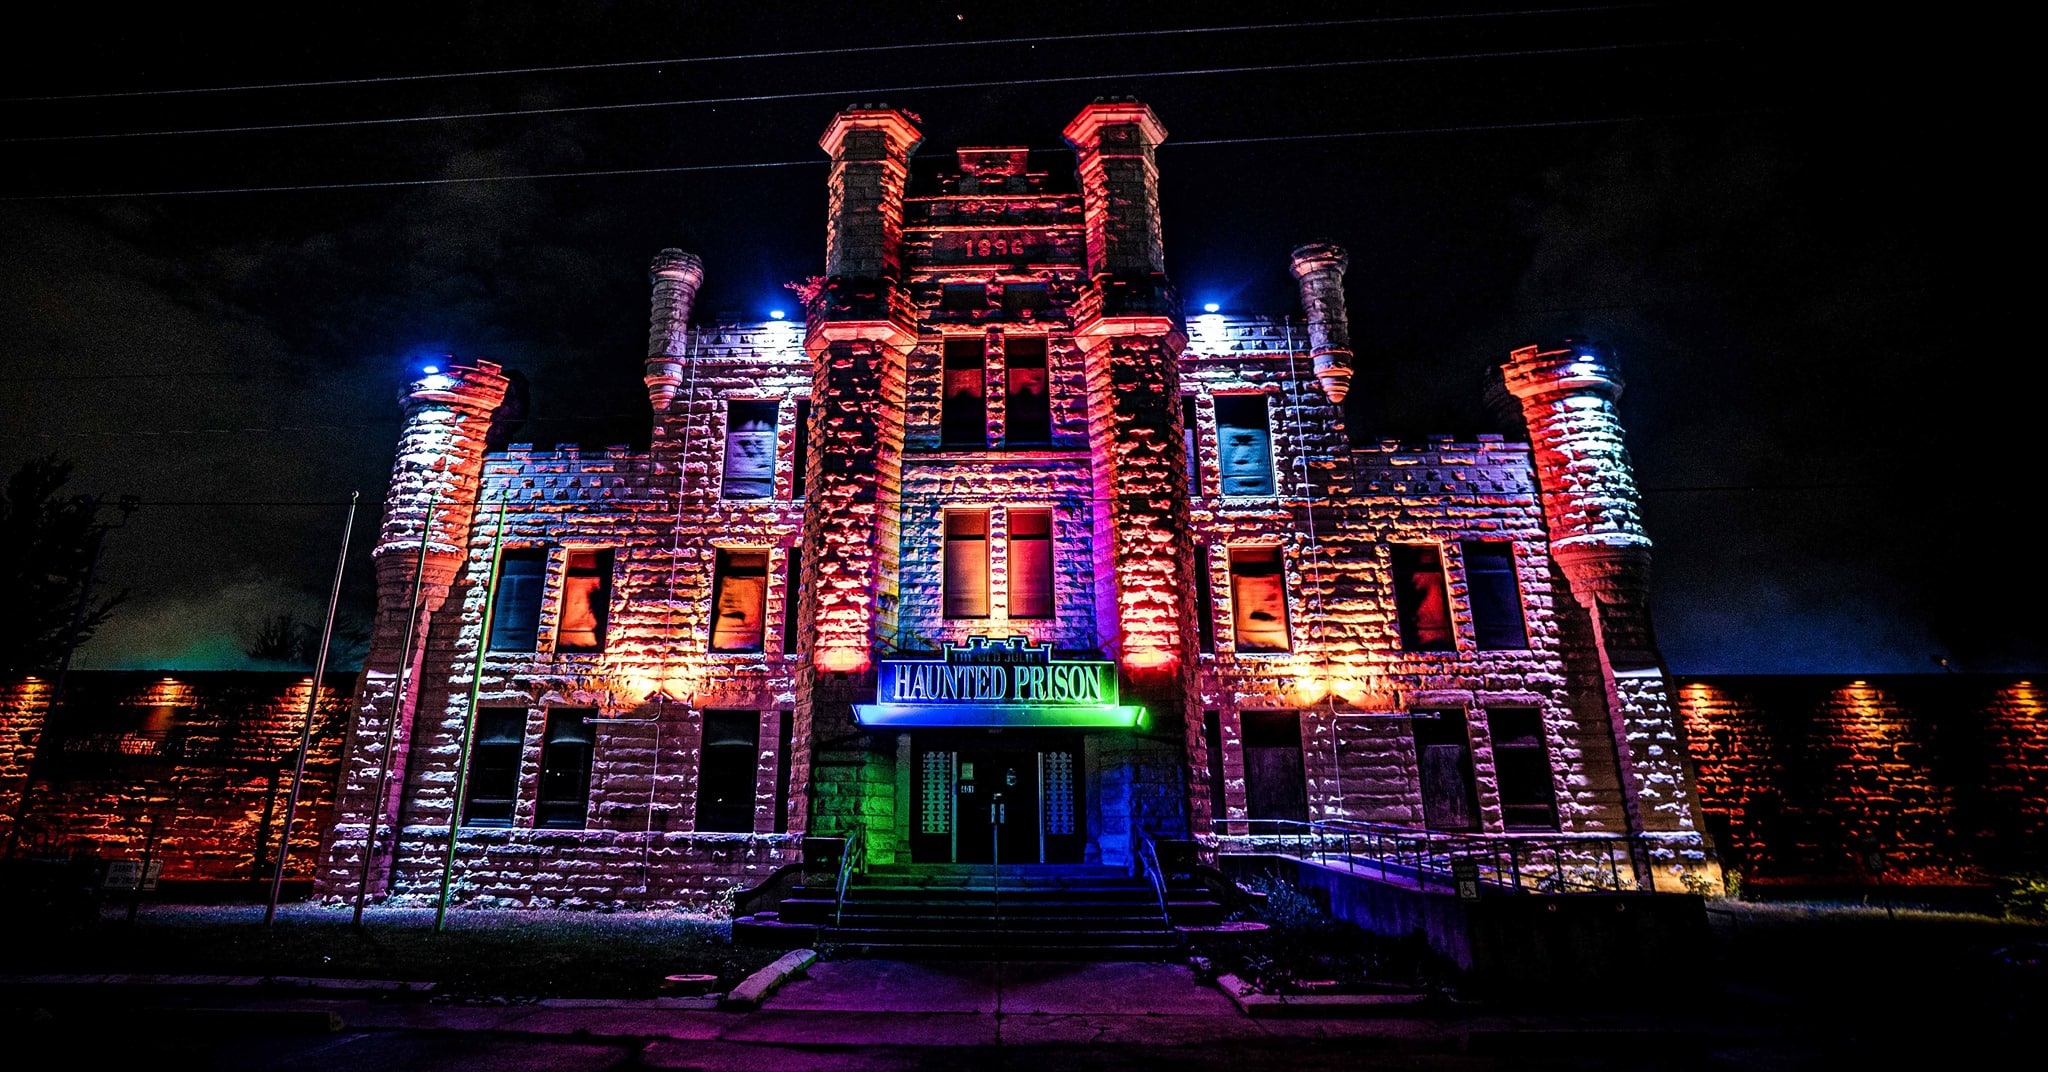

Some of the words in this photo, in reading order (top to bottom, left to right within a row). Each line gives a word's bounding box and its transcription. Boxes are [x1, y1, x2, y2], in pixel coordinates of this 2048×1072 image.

[964, 239, 1024, 257] 1896
[893, 664, 1007, 701] HAUNTED
[1014, 665, 1102, 701] PRISON
[961, 785, 974, 793] 401
